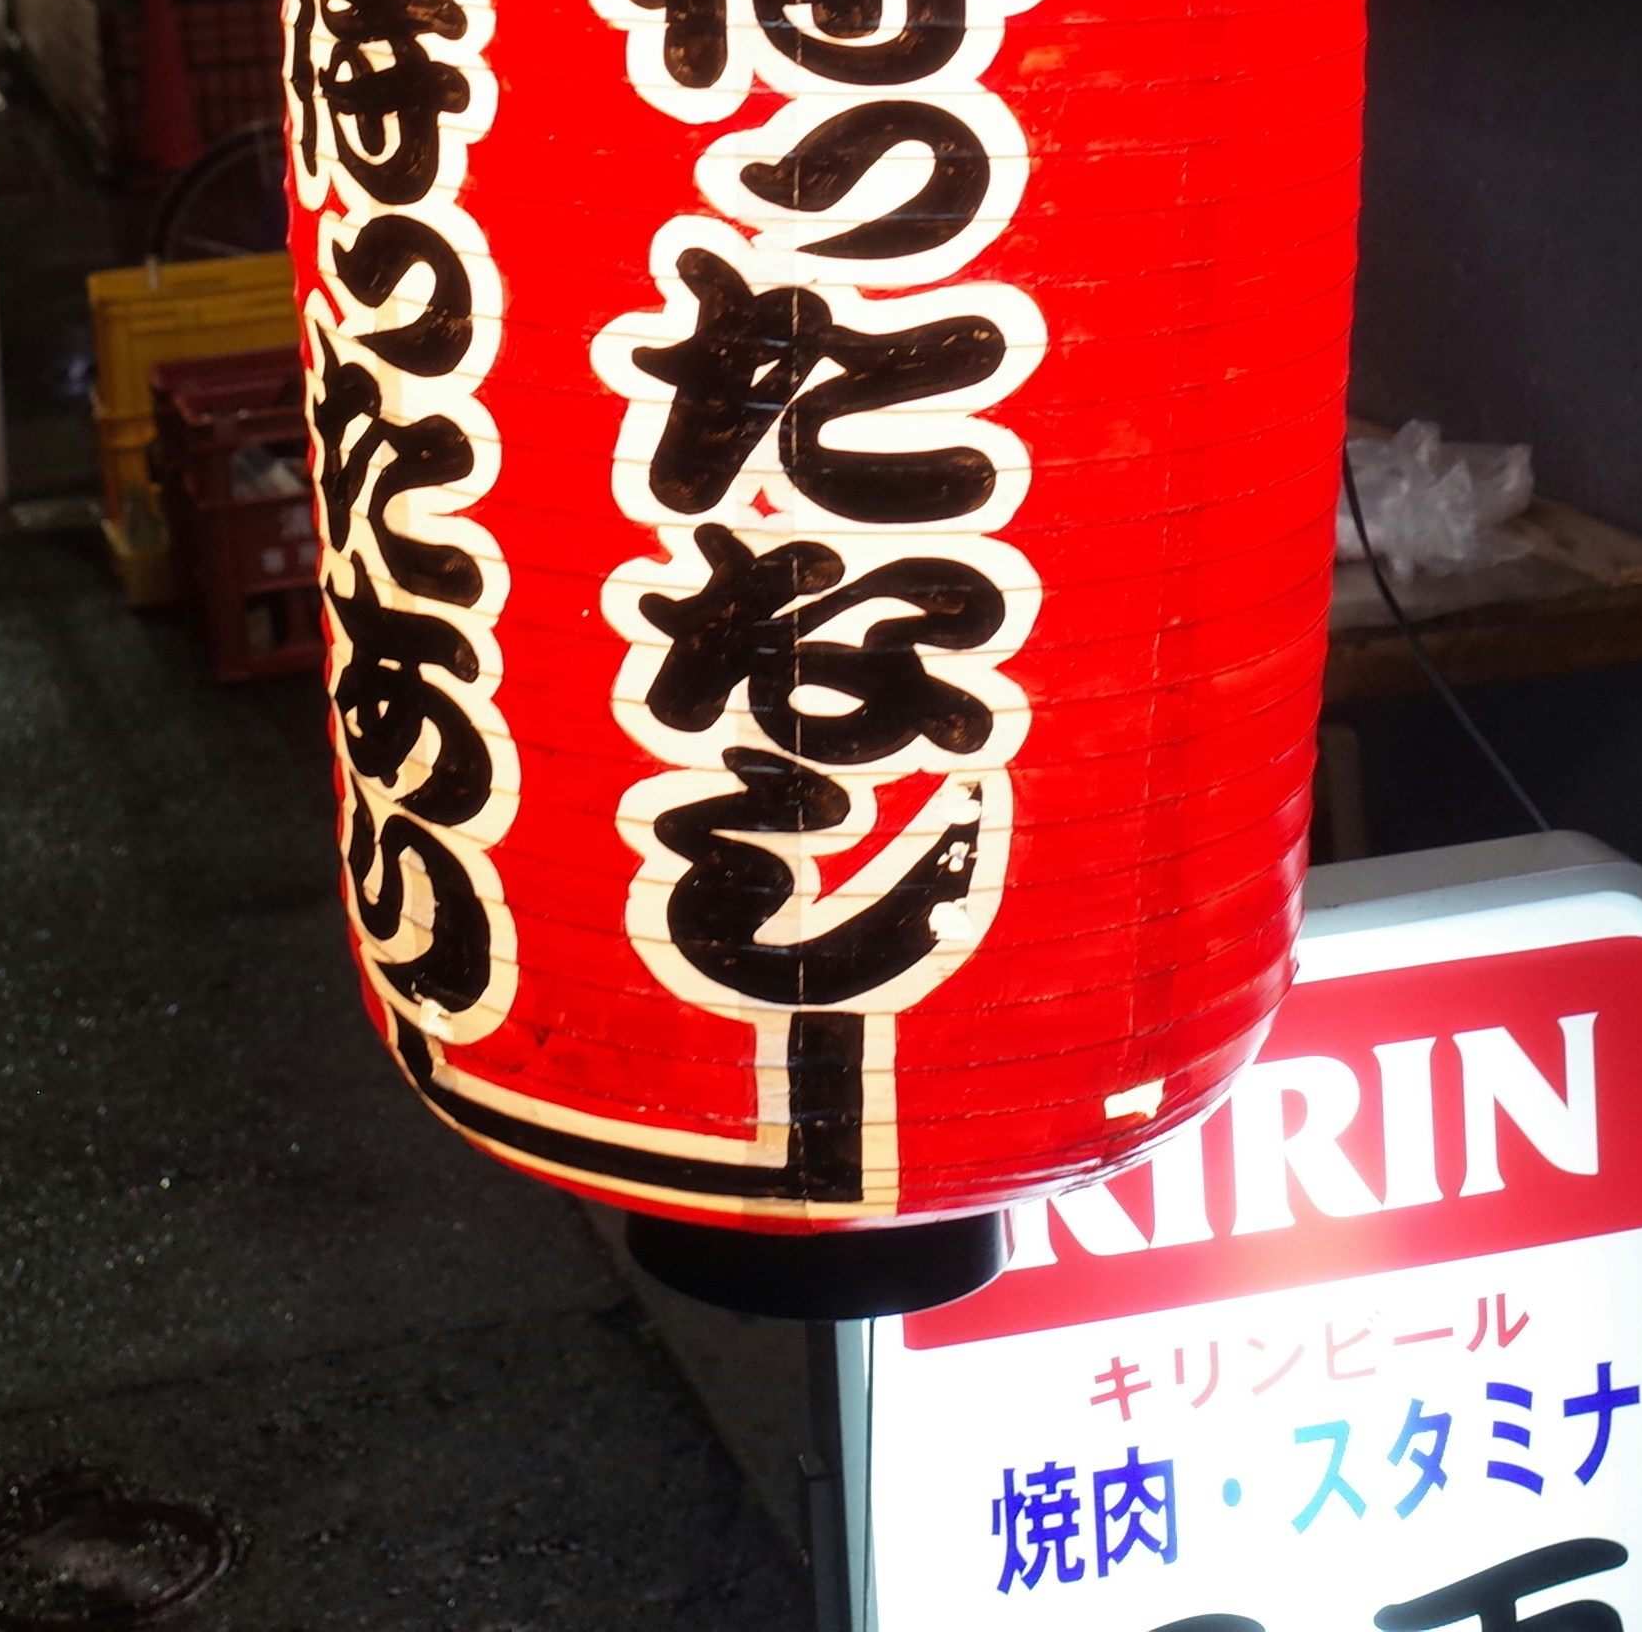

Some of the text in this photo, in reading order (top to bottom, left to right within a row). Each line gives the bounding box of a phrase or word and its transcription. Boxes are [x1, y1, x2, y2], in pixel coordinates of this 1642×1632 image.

[1089, 1292, 1530, 1422] キリンビール
[991, 1360, 1641, 1595] 焼肉・スタミナ
